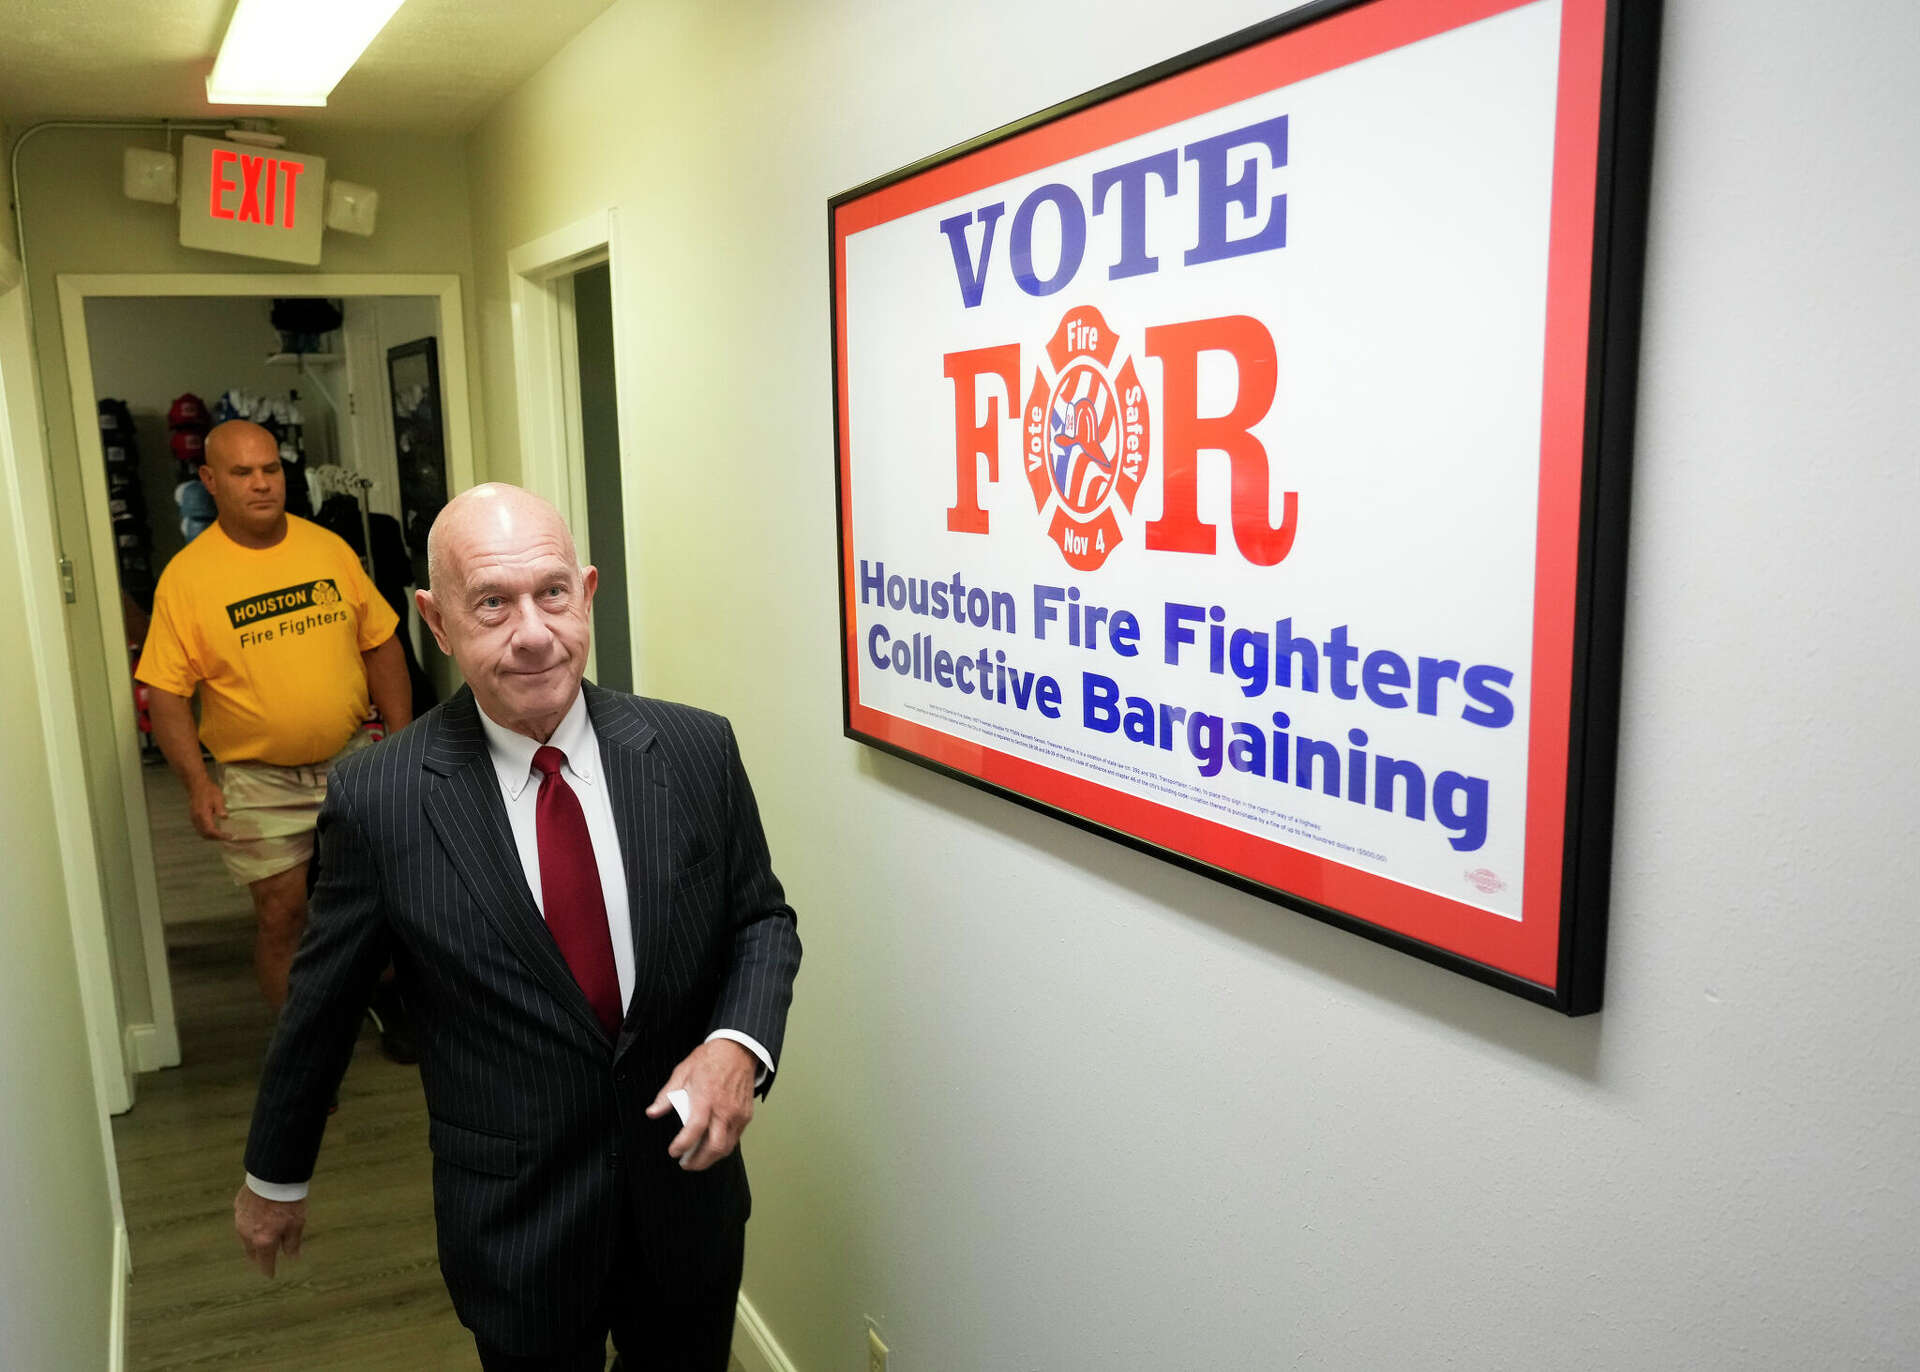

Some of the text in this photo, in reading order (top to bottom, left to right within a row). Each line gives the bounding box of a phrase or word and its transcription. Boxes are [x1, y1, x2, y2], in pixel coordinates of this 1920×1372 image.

[210, 148, 305, 230] EXIT
[940, 114, 1289, 309] VOTE
[1066, 319, 1098, 353] Fire
[1028, 405, 1043, 473] Vote
[1122, 384, 1143, 483] Safety
[1064, 527, 1106, 556] Nov 4
[234, 590, 307, 622] HOUSTON
[240, 610, 347, 648] Fire Fighters
[861, 560, 1515, 729] Houston Fire Fighters
[867, 622, 1490, 853] Collective Bargaining
